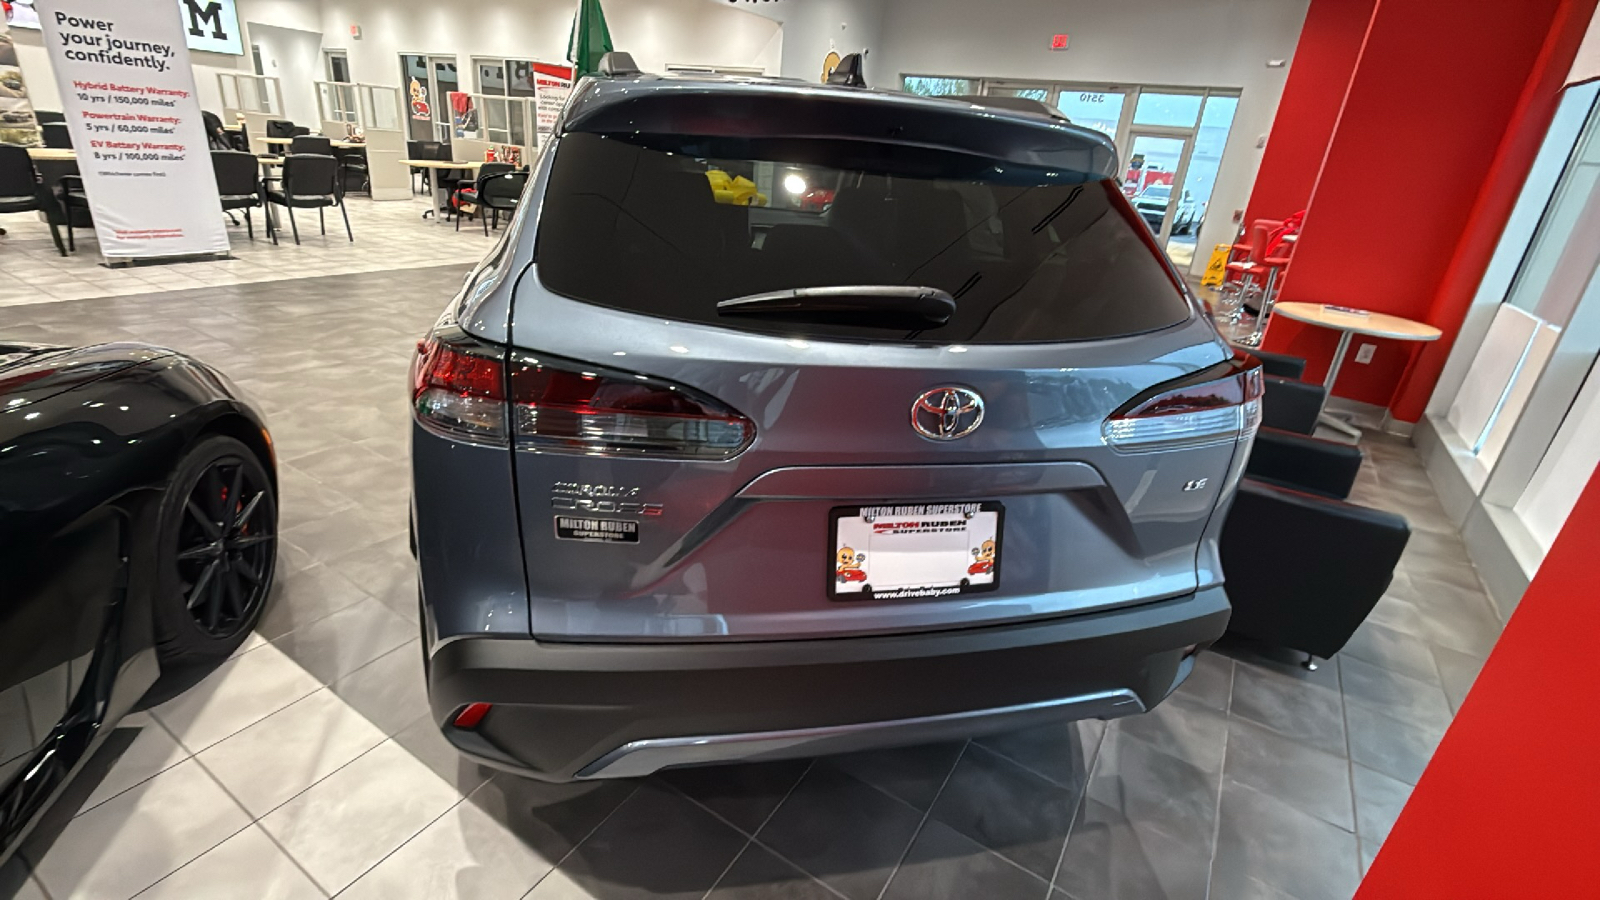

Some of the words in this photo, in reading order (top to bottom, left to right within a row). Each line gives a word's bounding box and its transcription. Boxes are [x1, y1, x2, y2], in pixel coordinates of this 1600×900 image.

[54, 11, 114, 32] Power
[184, 0, 228, 40] M
[59, 32, 102, 46] your
[105, 34, 175, 58] journey,
[65, 49, 170, 72] confidently.
[73, 80, 108, 91] Hybrid
[110, 83, 144, 95] Battery
[145, 86, 190, 99] Warranty:
[537, 79, 560, 87] MILTON
[77, 92, 89, 101] 10
[90, 95, 105, 104] yrs
[113, 96, 149, 106] 150,000
[82, 111, 136, 121] Powertrain
[137, 114, 182, 125] Warranty:
[86, 123, 92, 131] 5
[94, 124, 109, 132] yrs
[117, 125, 149, 134] 60,000
[90, 140, 104, 148] EV
[105, 141, 140, 151] Battery
[141, 142, 186, 152] Warranty:
[94, 151, 101, 159] 8
[102, 153, 117, 161] yrs
[124, 152, 159, 161] 100,000
[551, 496, 664, 516] CROSS
[859, 505, 893, 518] MILTON
[894, 504, 925, 517] RUBEN
[926, 503, 983, 516] SUPERSTORE
[559, 518, 599, 531] MILTON
[600, 520, 636, 533] RUBEN
[872, 521, 920, 530] MILTON
[921, 519, 967, 528] RUBEN
[892, 526, 967, 534] SUPERSTORE
[572, 530, 625, 539] SUPERSTORE
[873, 587, 961, 600] www.drivebaby.com
